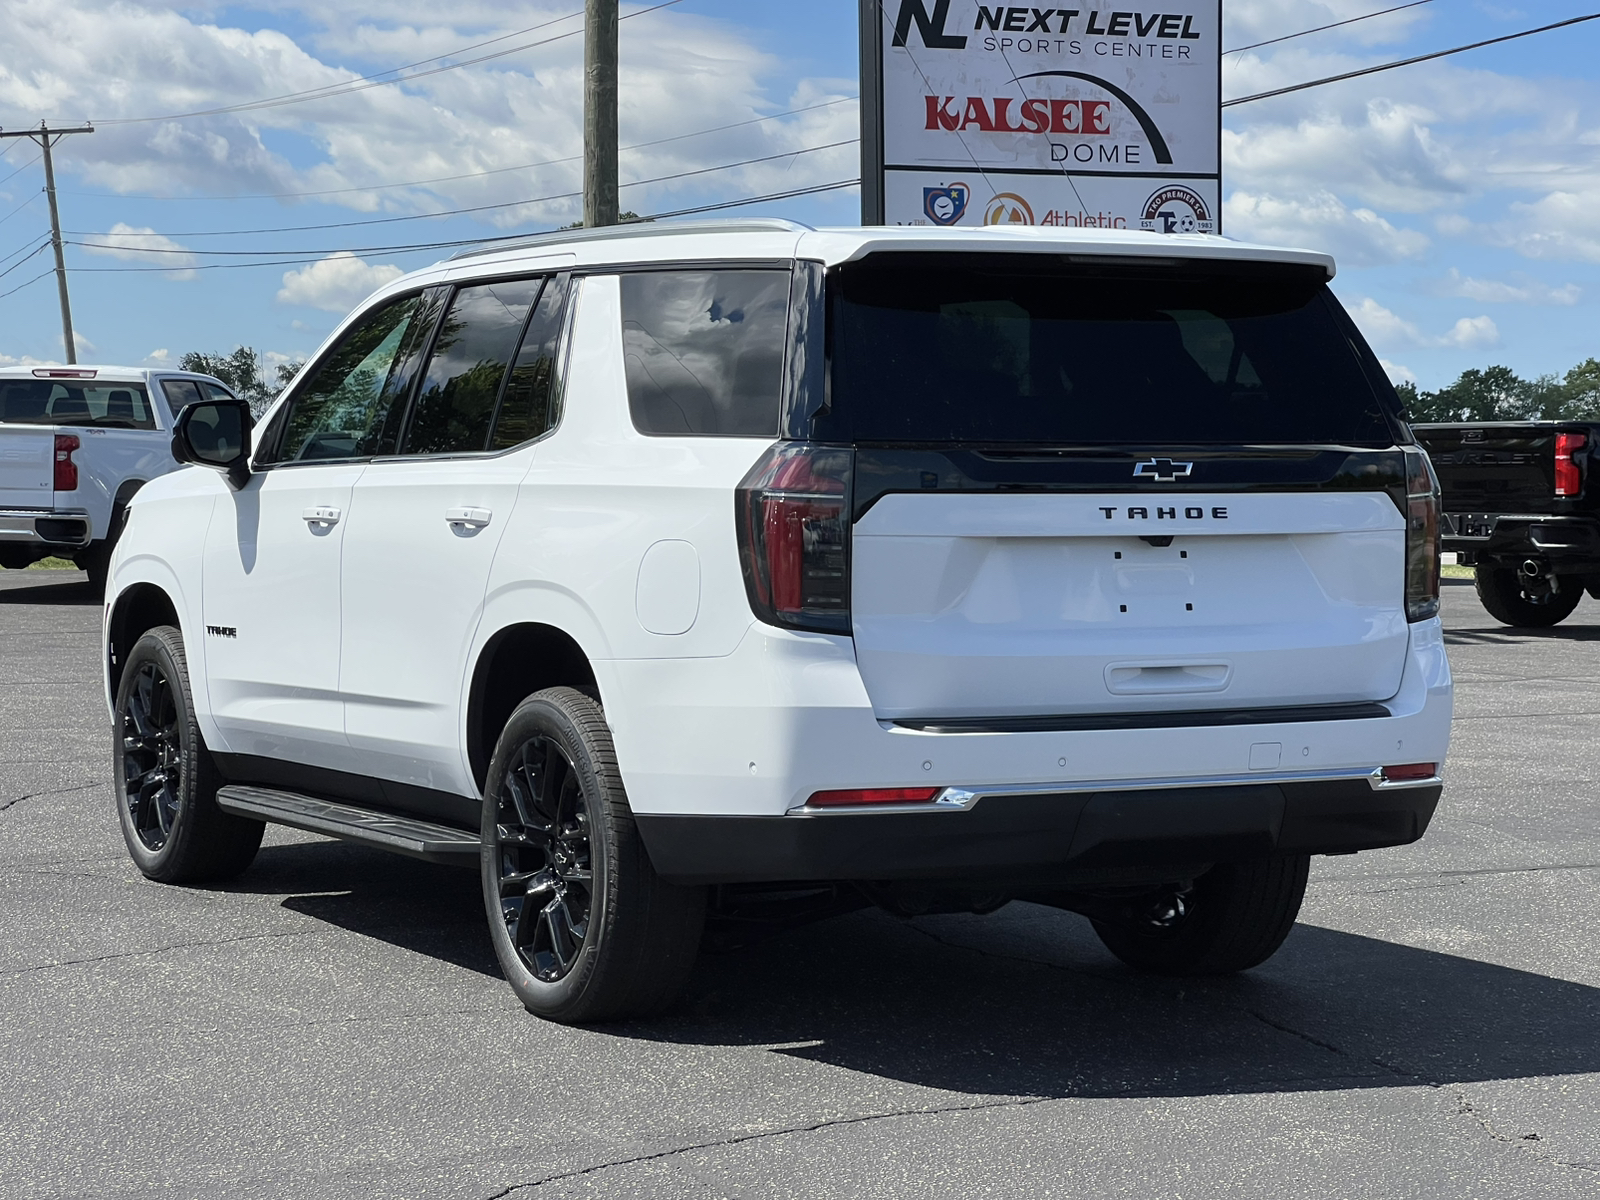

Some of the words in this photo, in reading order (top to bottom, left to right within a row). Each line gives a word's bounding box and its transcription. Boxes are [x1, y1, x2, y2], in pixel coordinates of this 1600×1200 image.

[891, 0, 968, 49] NL
[974, 6, 1079, 34] NEXT
[1085, 10, 1201, 39] LEVEL
[983, 37, 1082, 55] SPORTS
[1094, 41, 1191, 59] CENTER
[924, 95, 1111, 135] KALSEE
[1050, 143, 1141, 164] DOME
[1148, 198, 1162, 212] TKO
[1162, 190, 1195, 205] PREMIER
[1040, 210, 1127, 229] Athletic
[1141, 220, 1154, 228] EST.
[1430, 453, 1541, 465] HEVROLET
[1098, 507, 1228, 519] TAHOE
[206, 625, 237, 639] TAHOE
